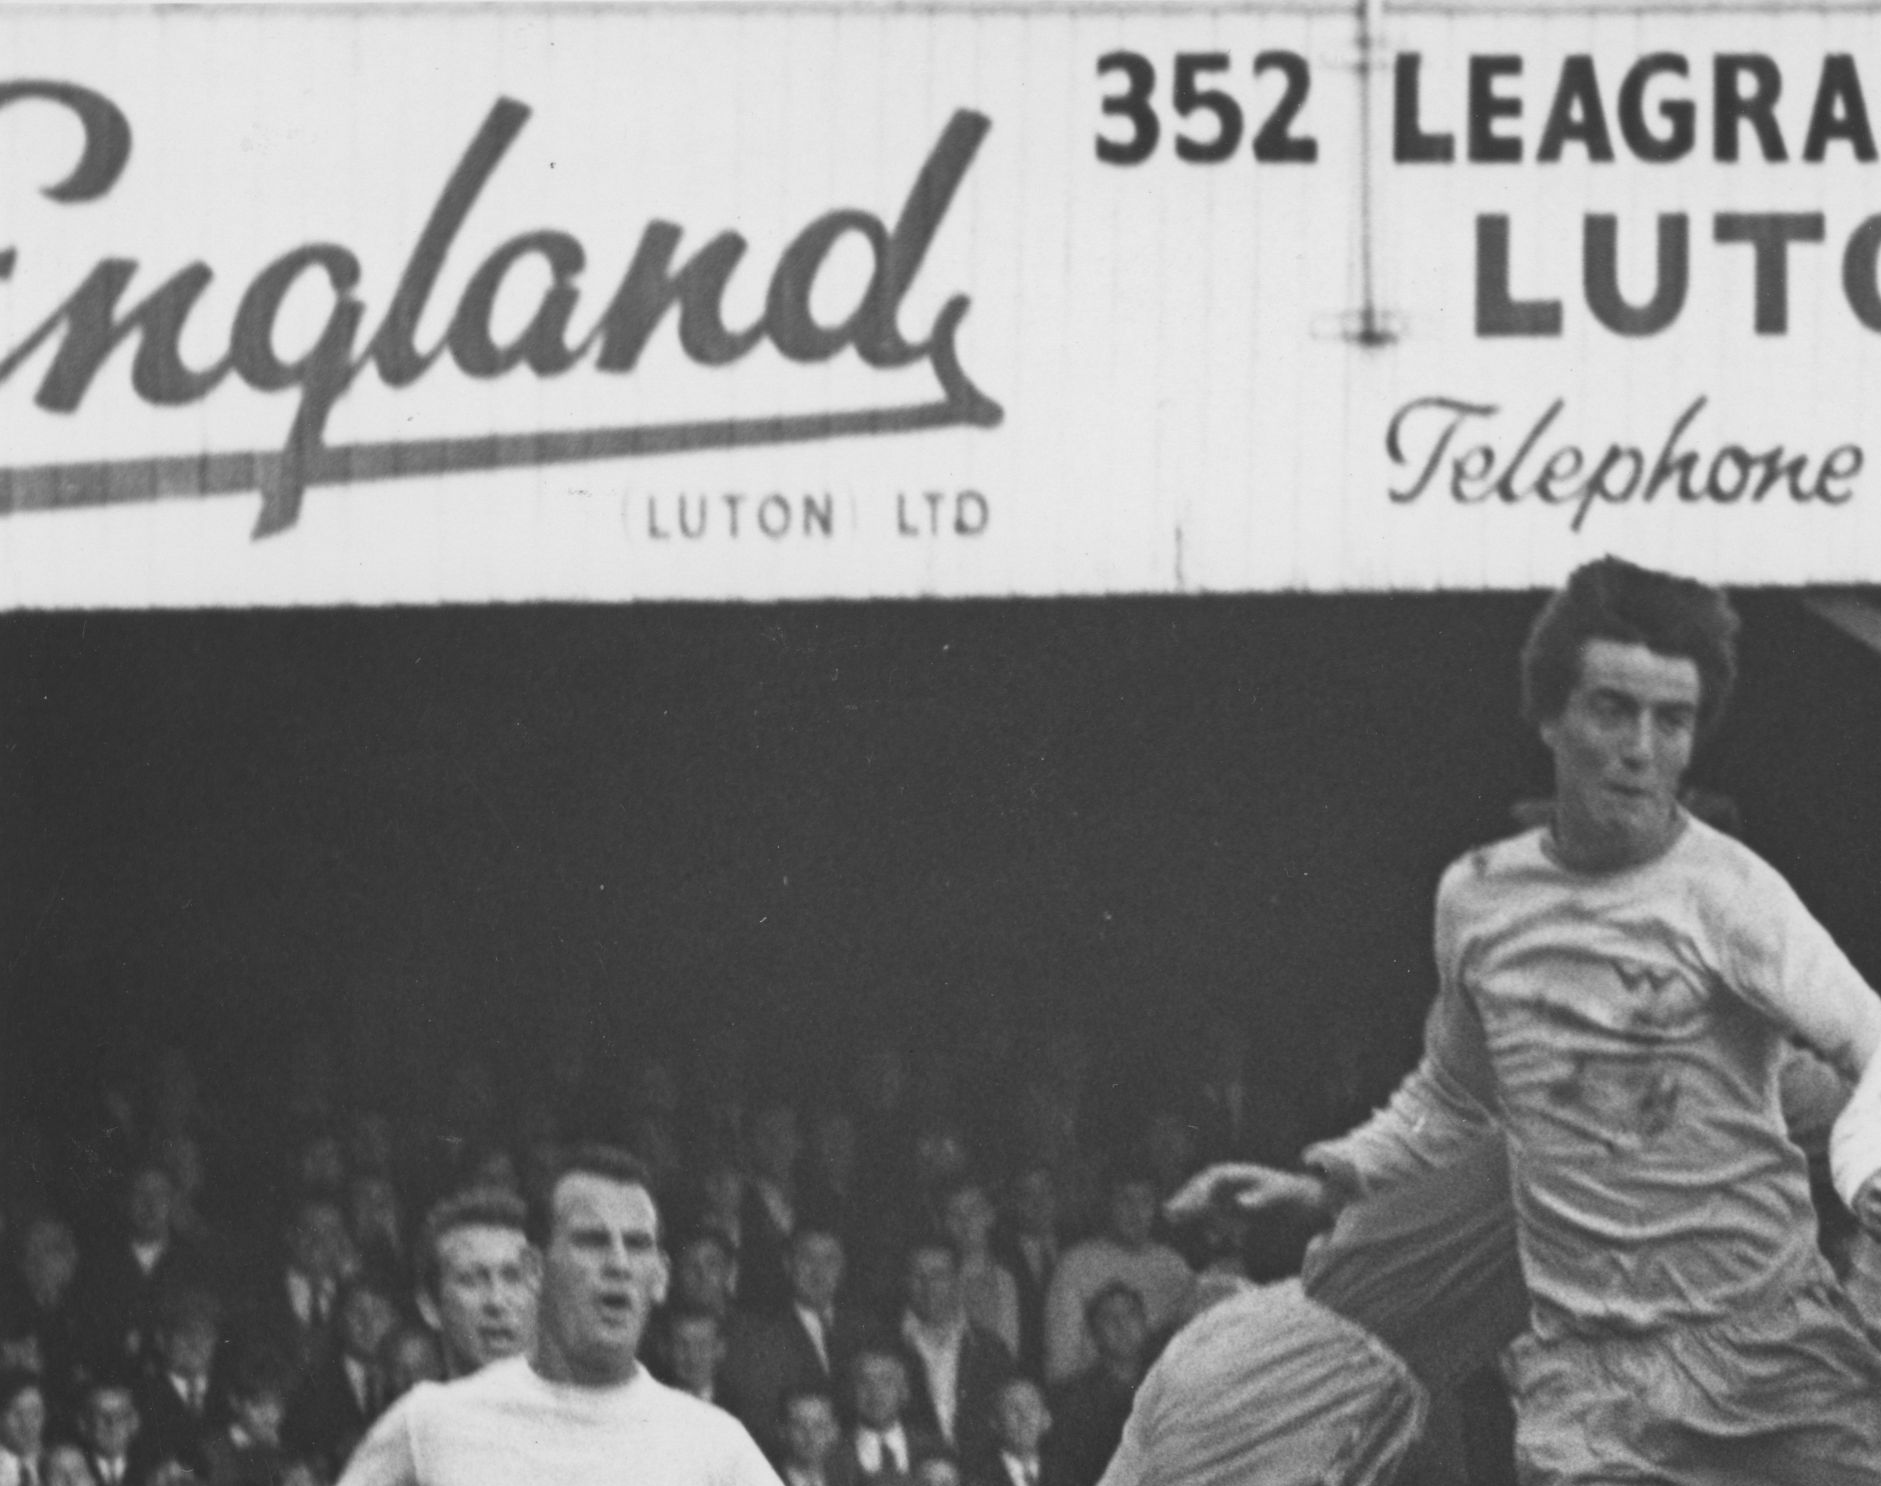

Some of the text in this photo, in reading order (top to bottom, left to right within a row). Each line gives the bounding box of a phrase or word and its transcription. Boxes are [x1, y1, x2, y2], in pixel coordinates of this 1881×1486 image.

[1095, 51, 1319, 166] 352
[897, 488, 990, 538] LTD
[1385, 394, 1865, 534] Telephone
